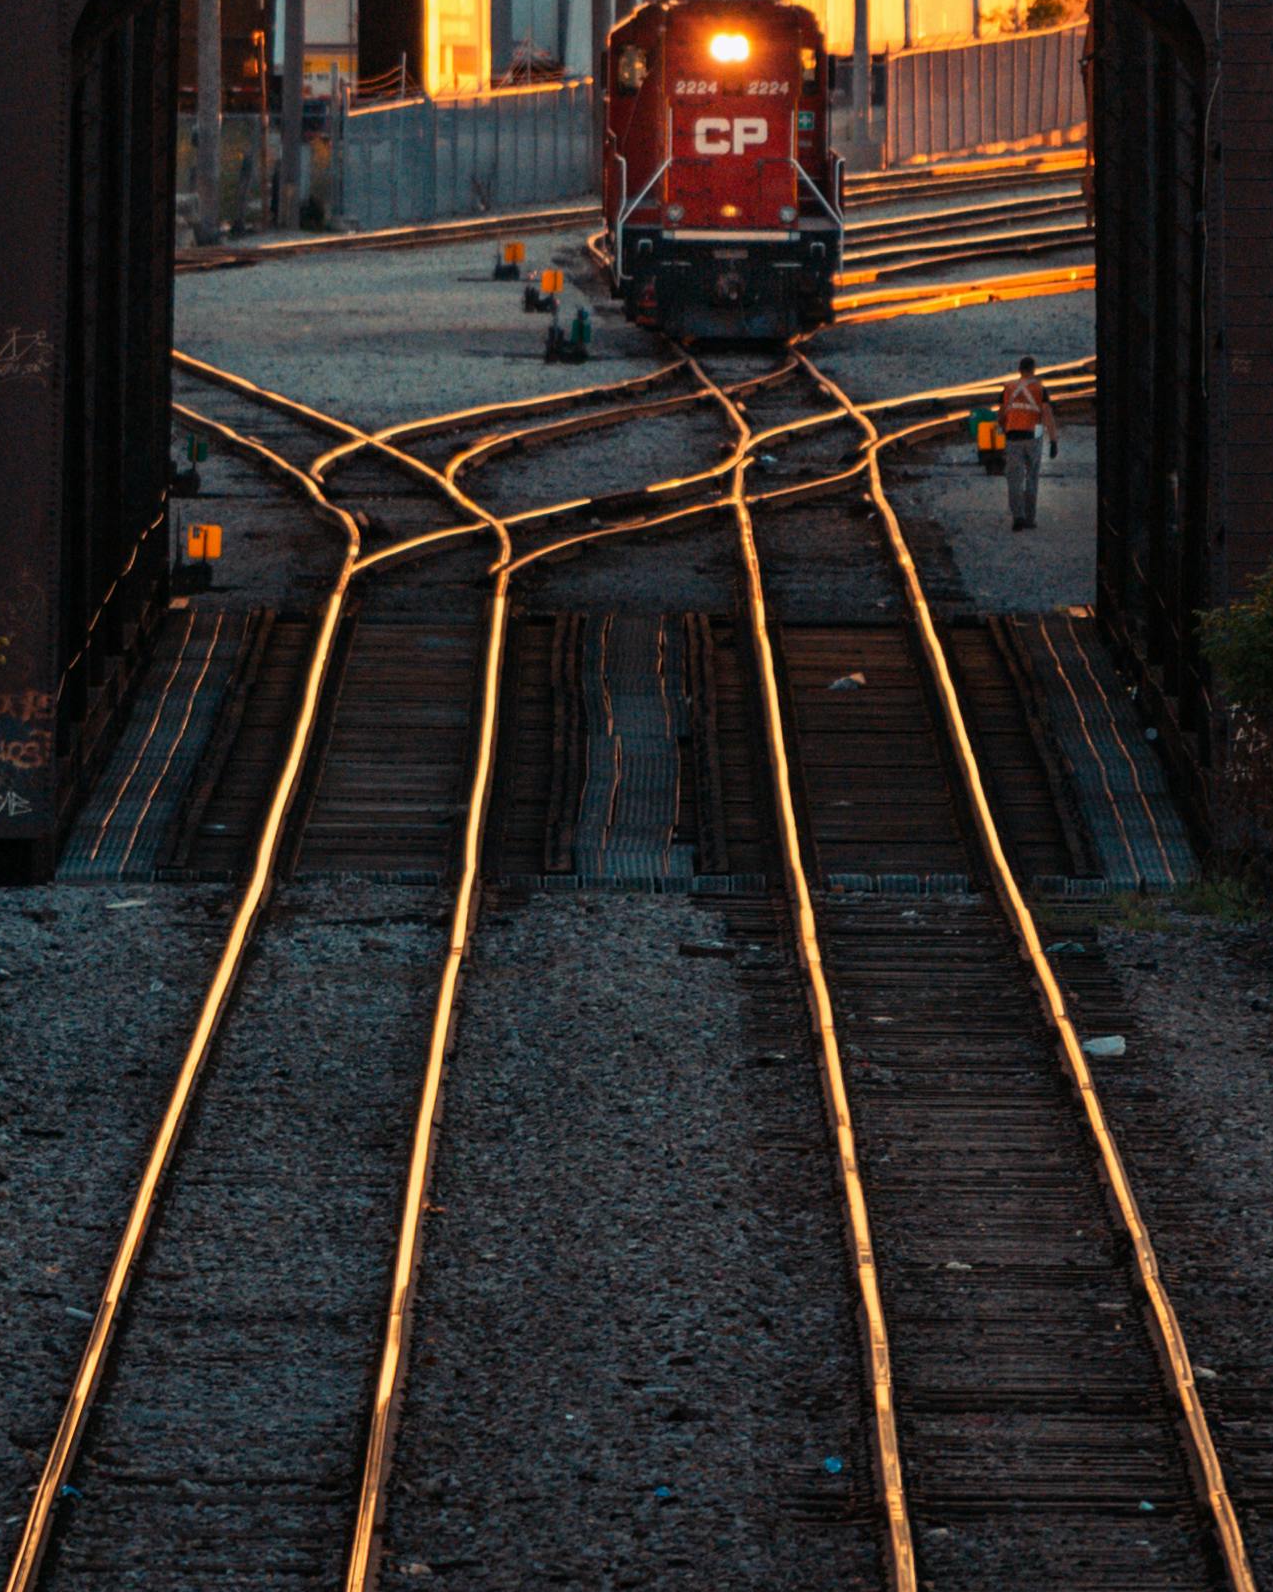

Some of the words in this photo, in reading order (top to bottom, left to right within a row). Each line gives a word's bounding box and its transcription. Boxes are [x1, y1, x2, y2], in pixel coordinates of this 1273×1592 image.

[675, 80, 718, 95] 2224
[747, 80, 790, 95] 2224
[694, 117, 768, 156] CP
